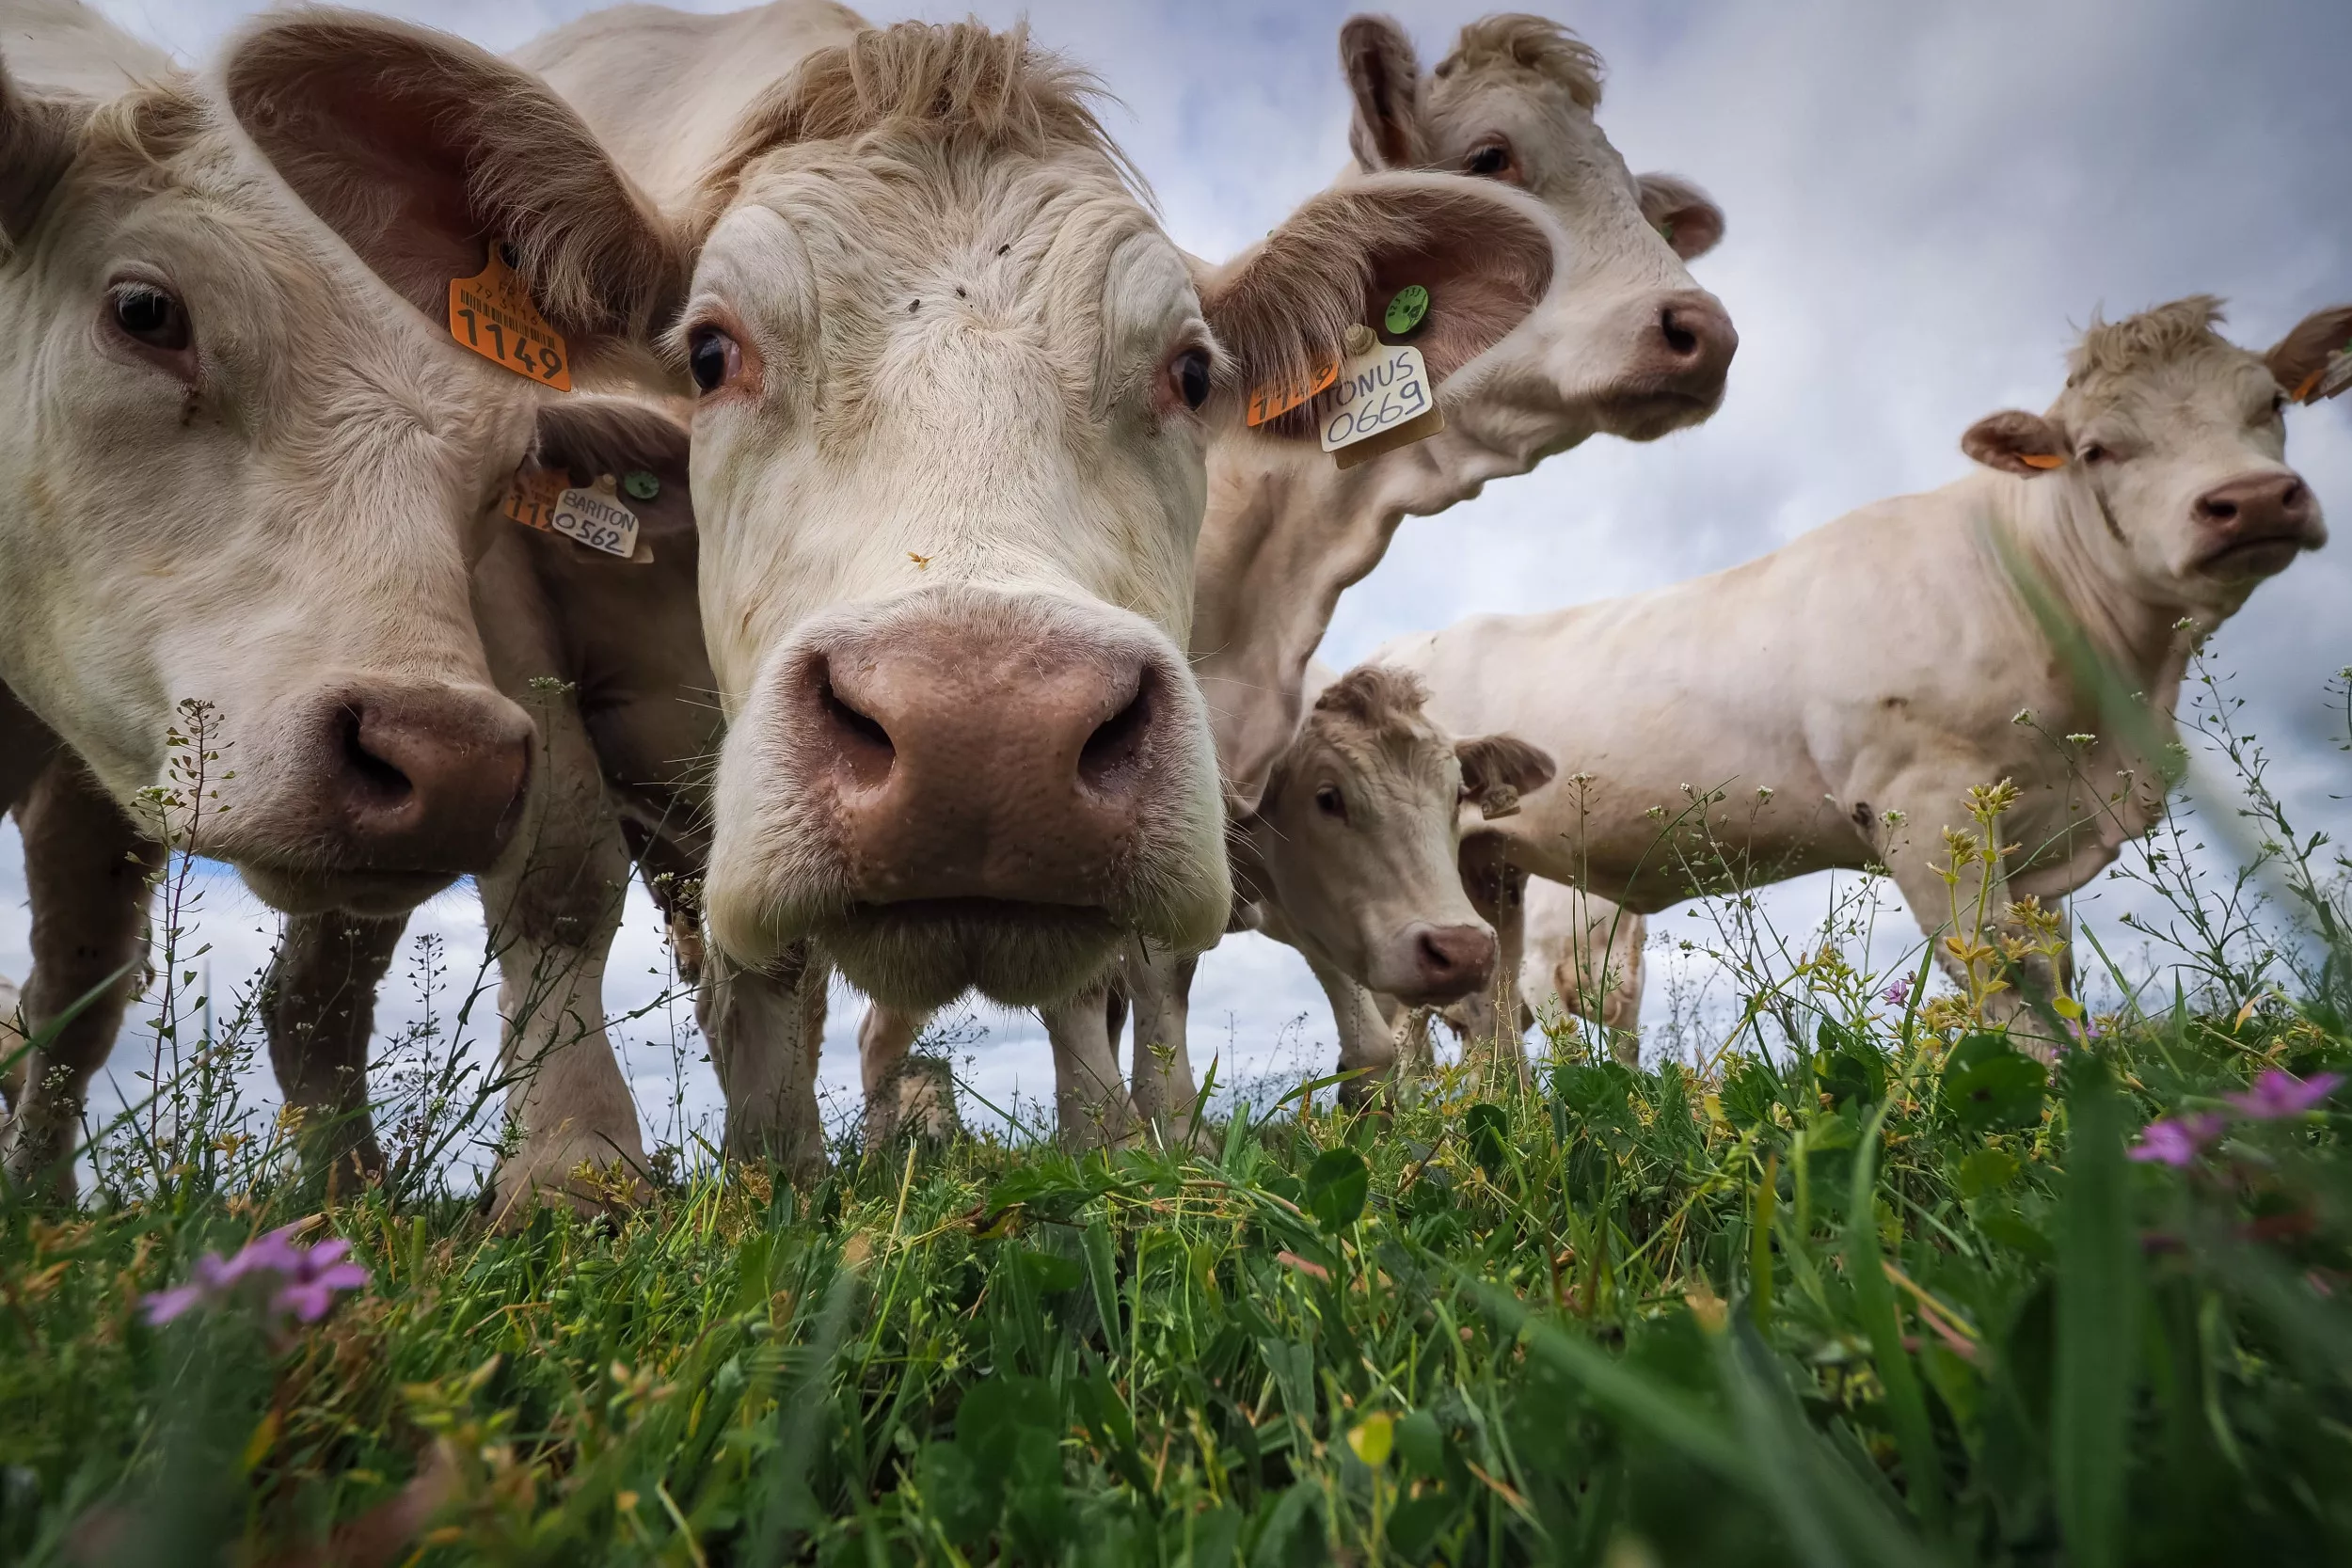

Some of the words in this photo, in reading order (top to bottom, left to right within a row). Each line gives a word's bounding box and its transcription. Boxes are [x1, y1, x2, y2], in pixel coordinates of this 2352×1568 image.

[457, 309, 563, 380] 1149
[1318, 351, 1414, 412] TONUS
[1327, 379, 1425, 443] 0669
